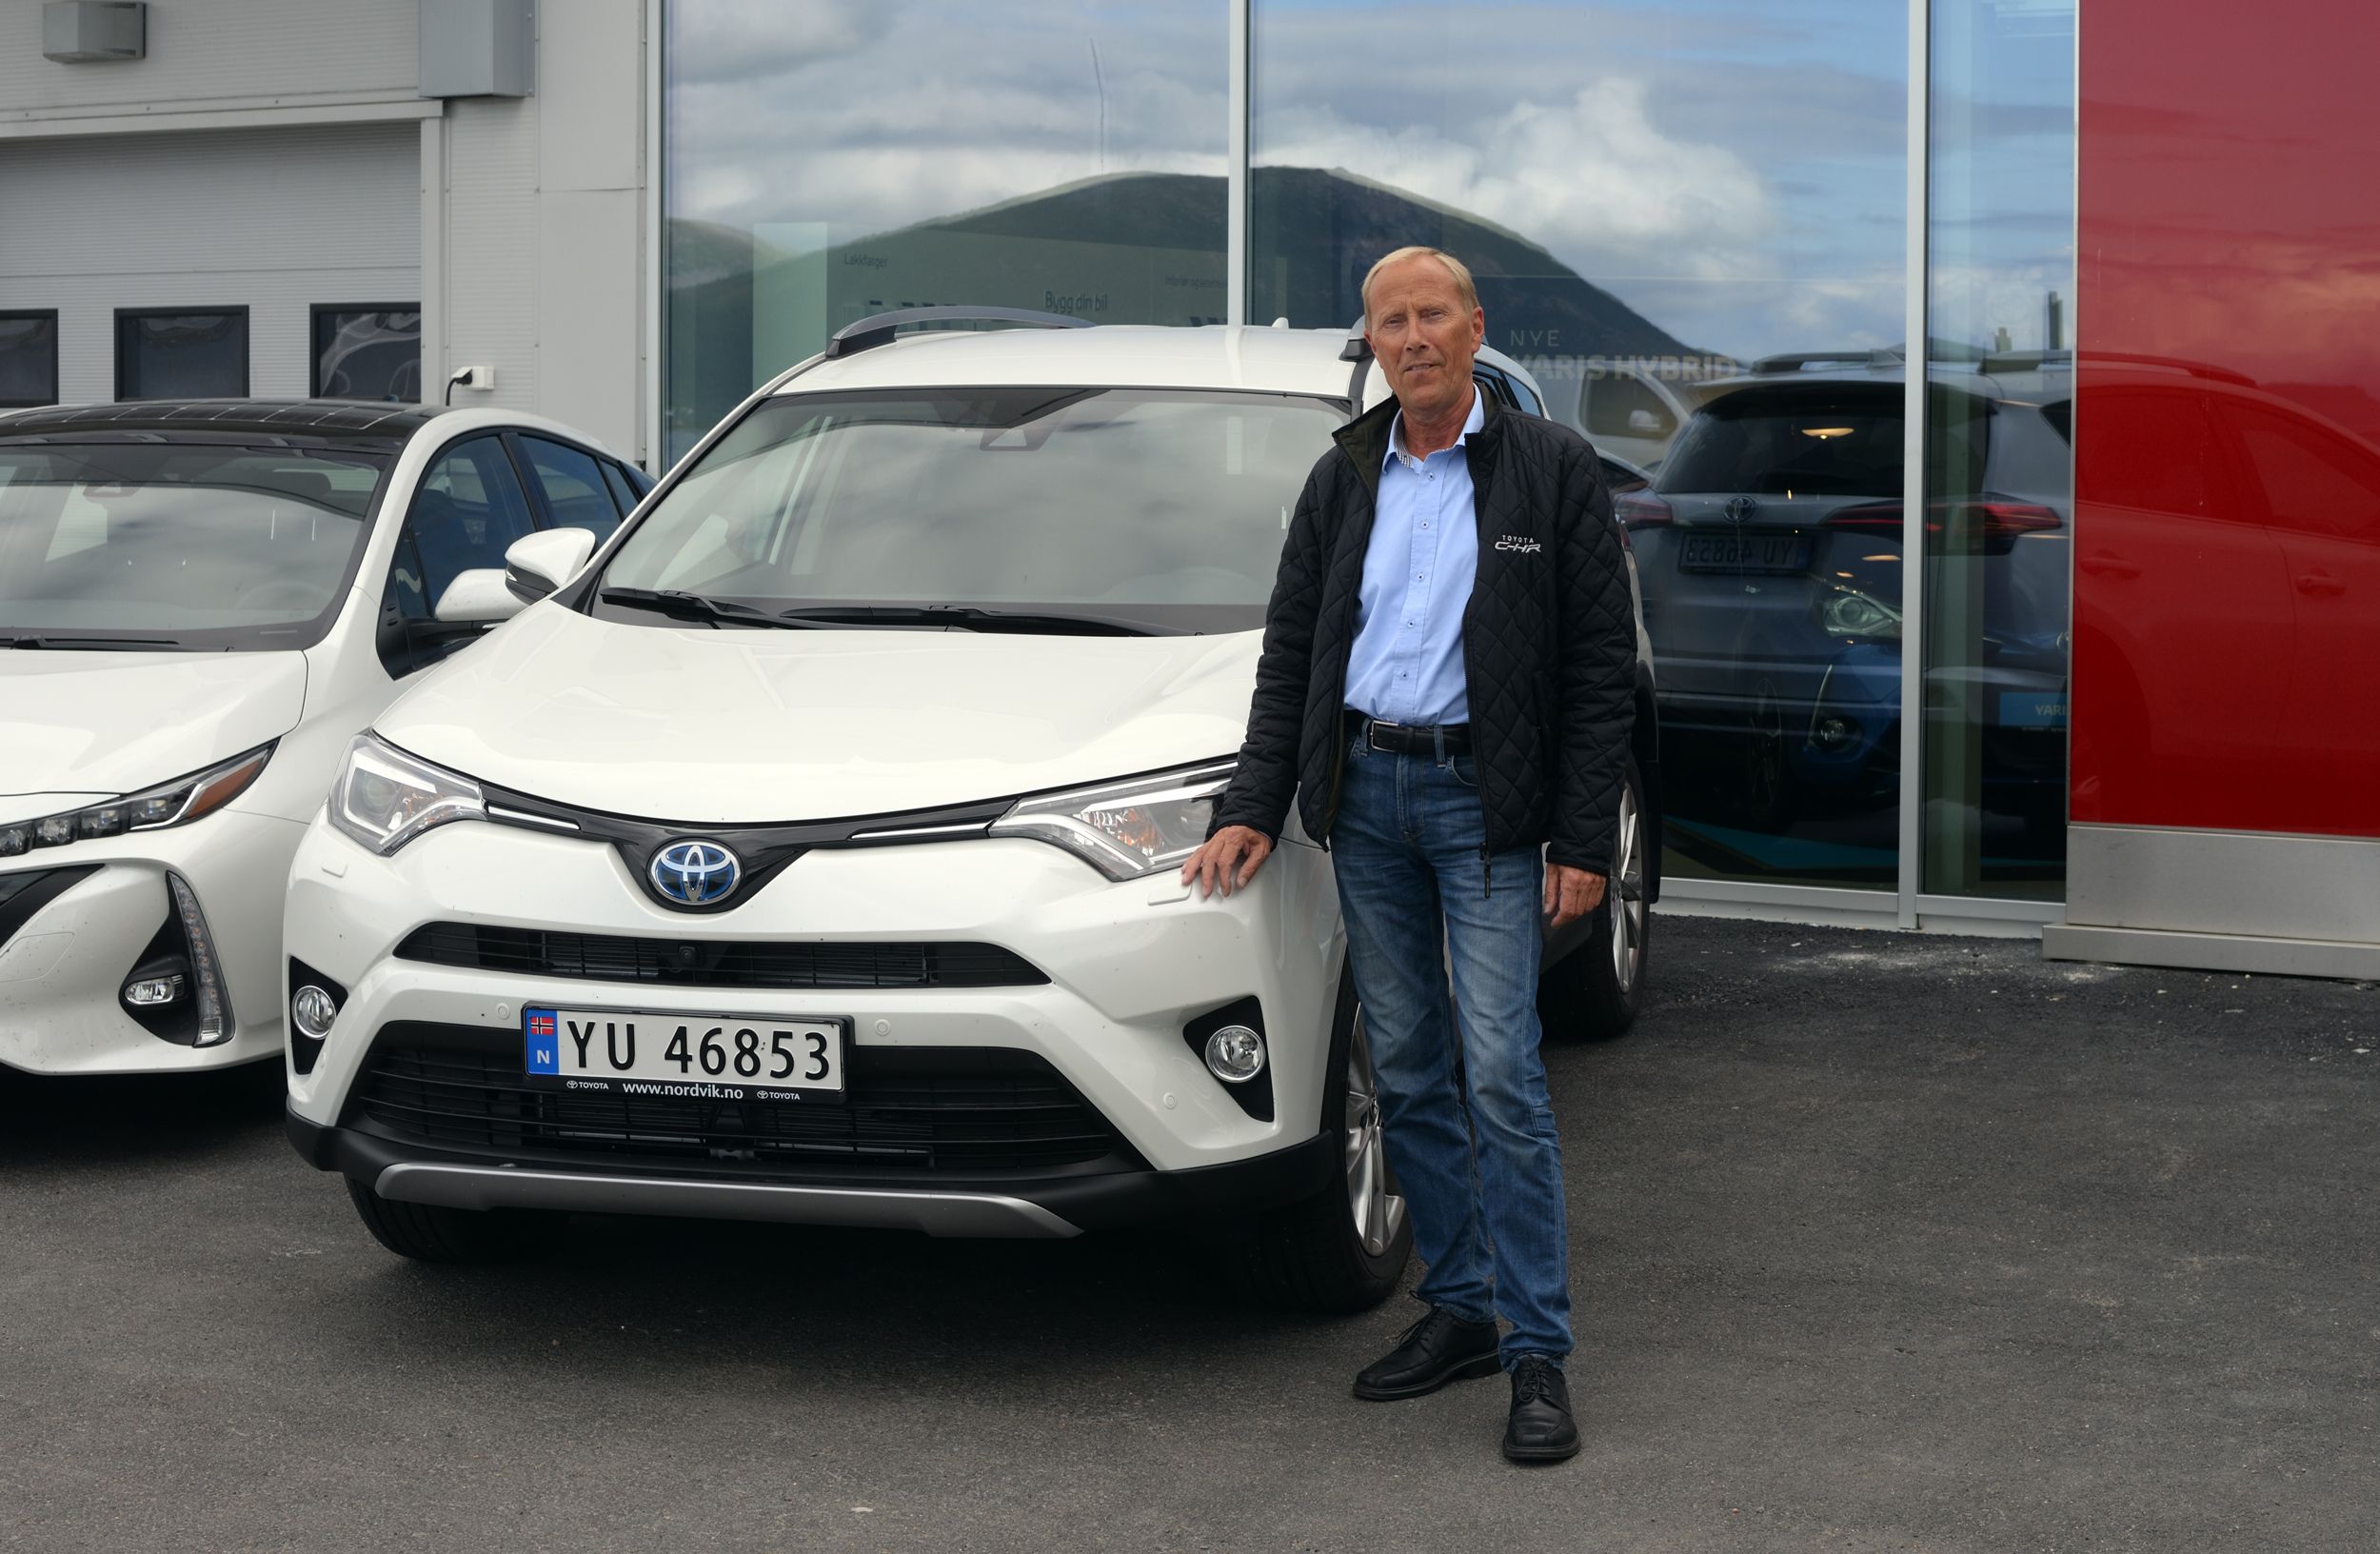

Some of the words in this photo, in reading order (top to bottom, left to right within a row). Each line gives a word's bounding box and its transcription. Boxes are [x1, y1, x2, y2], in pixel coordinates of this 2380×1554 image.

[1045, 290, 1074, 314] Bygg
[1076, 293, 1093, 311] din
[1095, 293, 1108, 311] bil
[1510, 329, 1560, 347] NYE
[1615, 355, 1737, 381] HYBRID
[1501, 534, 1535, 544] TOYOTA
[536, 1049, 551, 1065] N
[565, 1021, 637, 1071] YU
[664, 1025, 830, 1082] 46853
[578, 1081, 609, 1090] TOYOTA
[622, 1082, 744, 1100] www.nordvik.no
[768, 1091, 801, 1101] TOYOTA
